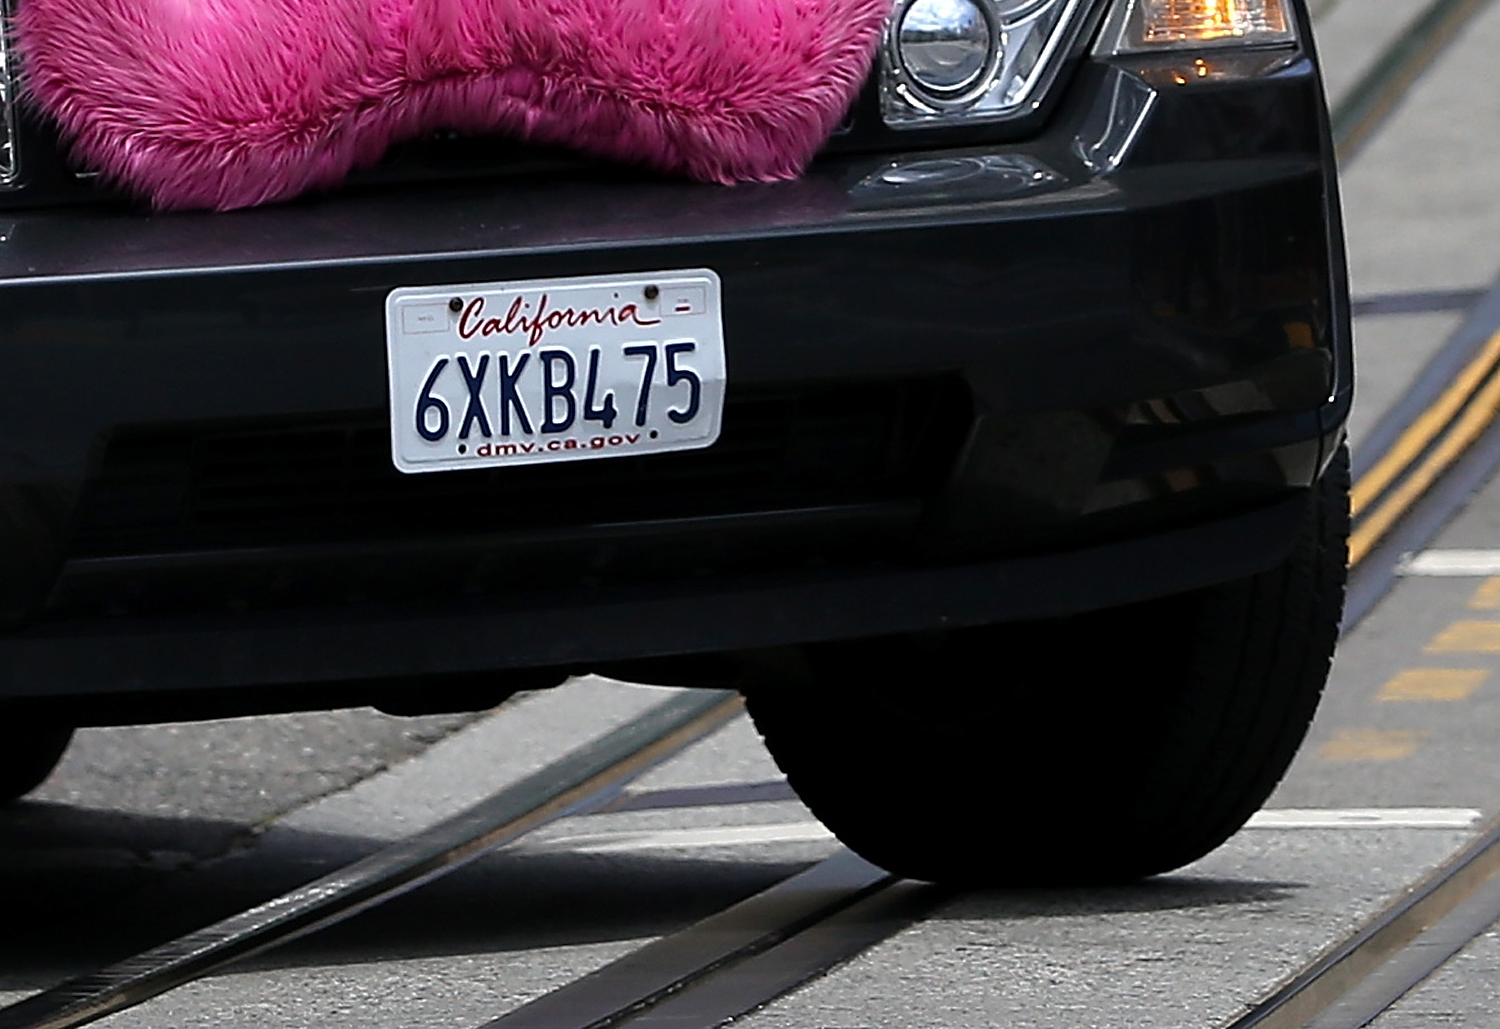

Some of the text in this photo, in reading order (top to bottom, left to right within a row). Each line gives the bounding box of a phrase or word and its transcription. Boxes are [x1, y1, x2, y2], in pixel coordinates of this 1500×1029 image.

[458, 293, 661, 346] California
[415, 341, 701, 442] 6XKB475
[476, 433, 641, 458] dmv.ca.gov
